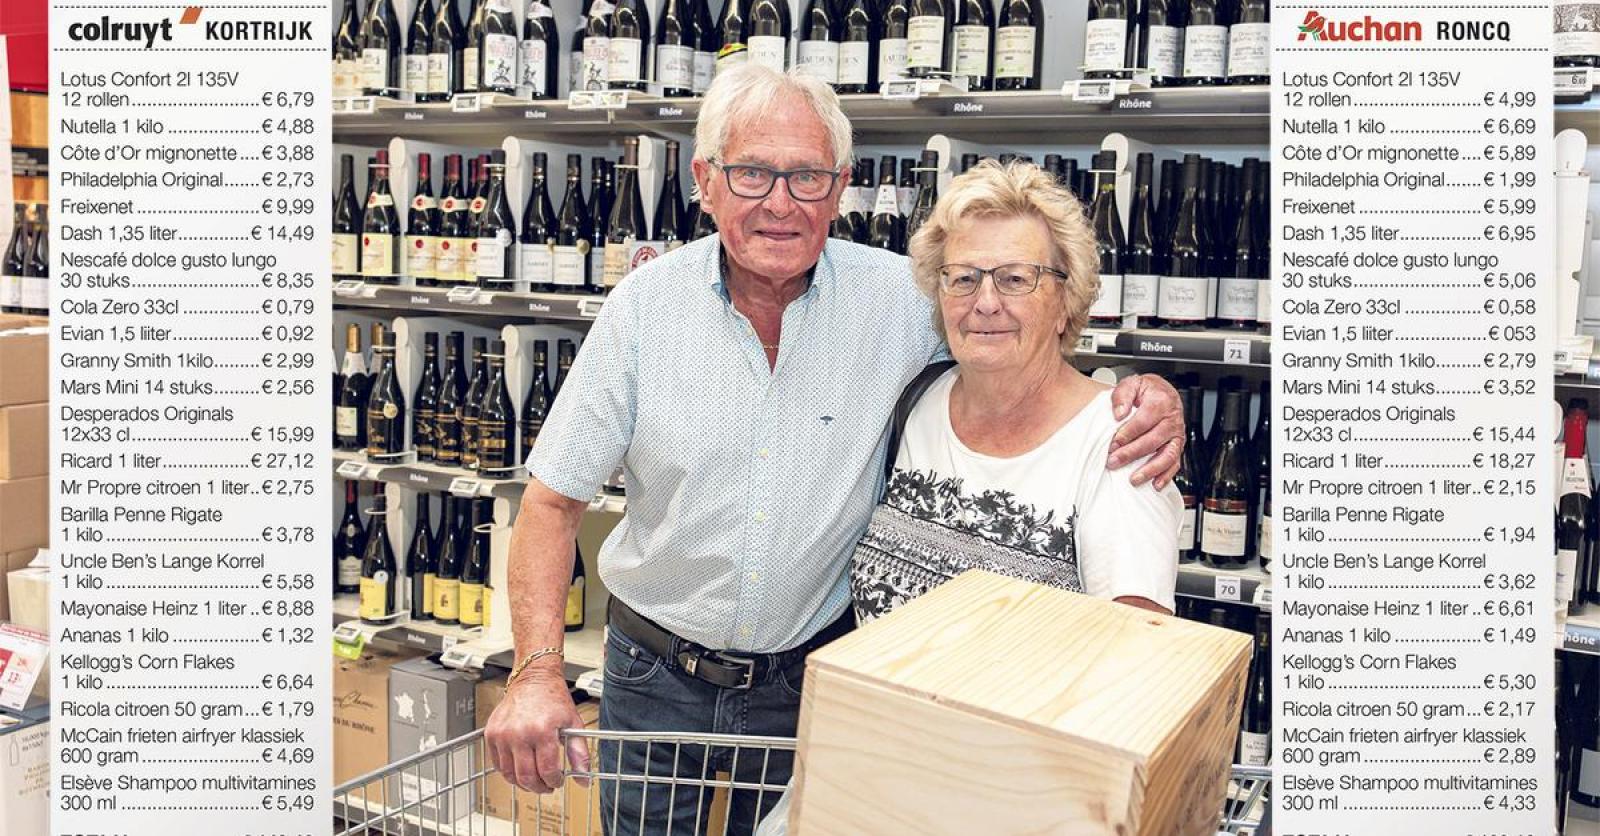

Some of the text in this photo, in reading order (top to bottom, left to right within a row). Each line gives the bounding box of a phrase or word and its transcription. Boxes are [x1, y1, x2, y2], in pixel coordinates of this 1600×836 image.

[954, 103, 983, 112] Rhône
[1119, 98, 1152, 109] Rhône
[659, 106, 682, 116] Rhône
[1140, 341, 1173, 353] Rhône
[1229, 349, 1242, 359] 71
[1221, 585, 1236, 595] 70
[1565, 633, 1597, 646] hône
